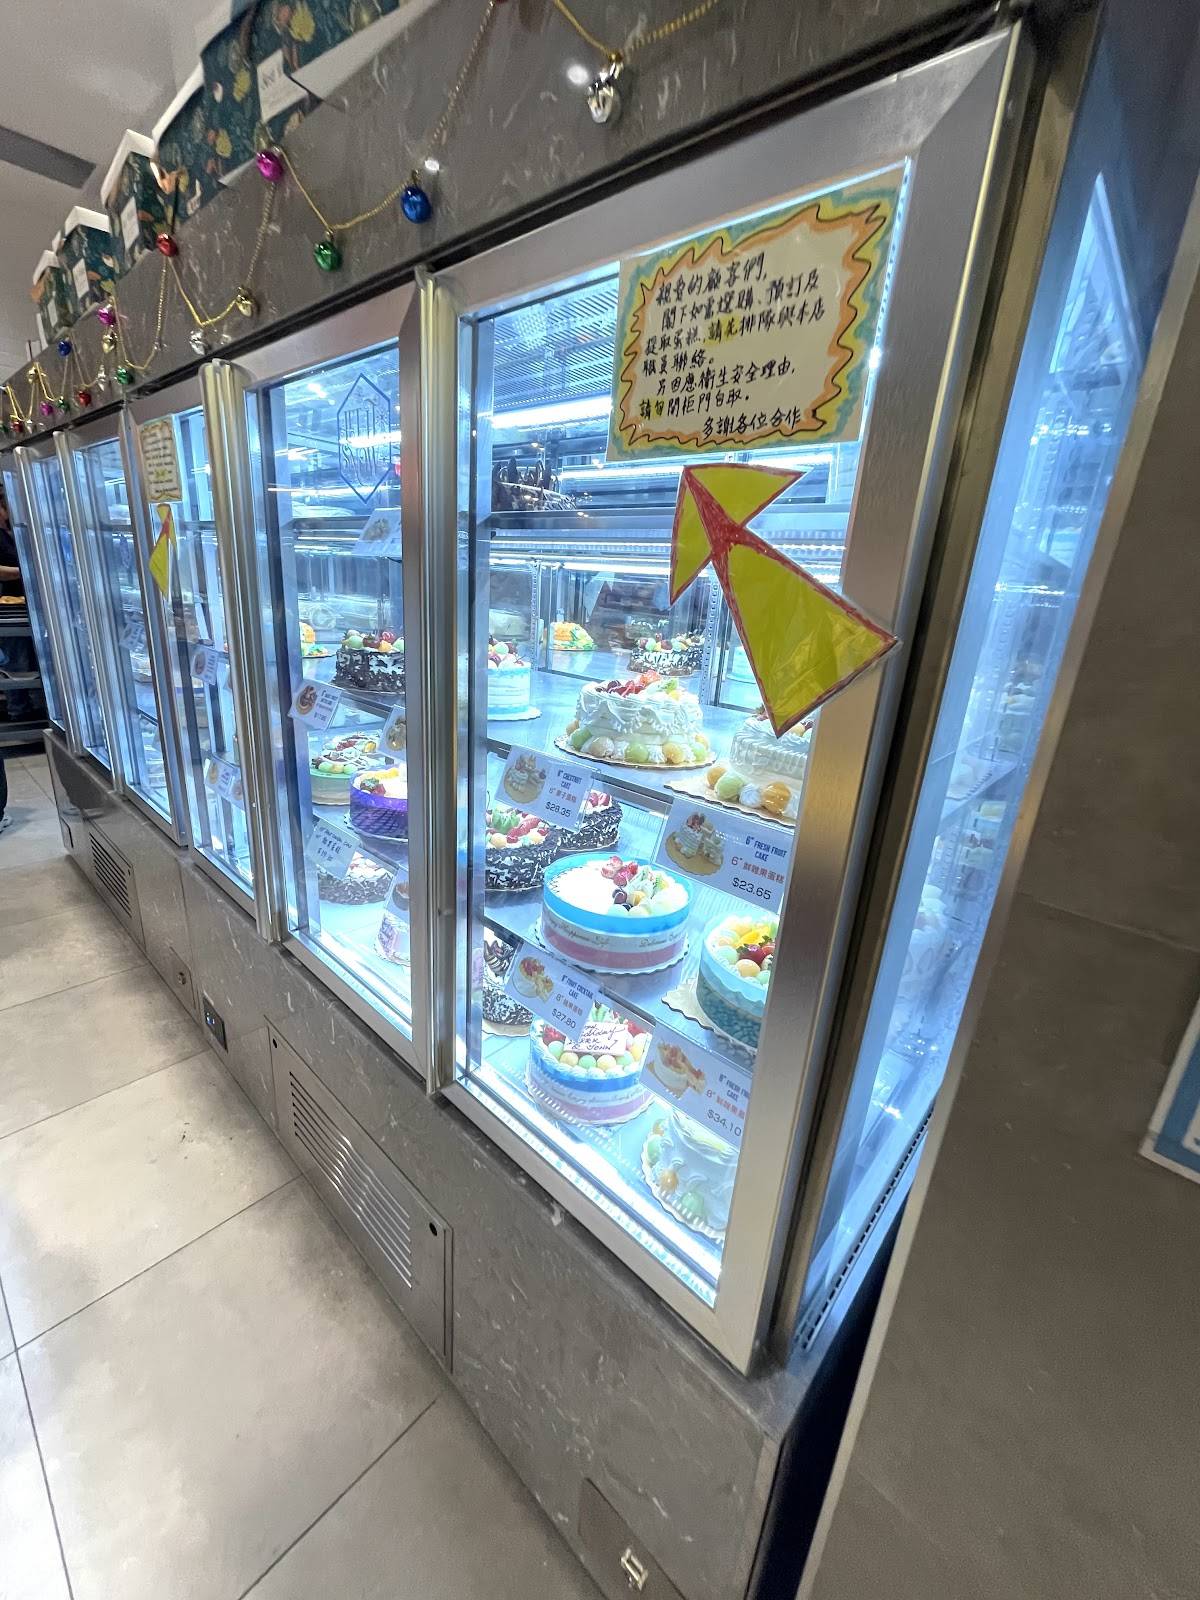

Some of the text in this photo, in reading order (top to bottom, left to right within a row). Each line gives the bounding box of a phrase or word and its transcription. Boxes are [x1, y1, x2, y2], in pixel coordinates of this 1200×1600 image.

[703, 407, 802, 439] 多謝各位合作
[545, 801, 571, 818] $28.35
[753, 840, 771, 853] FRESH
[771, 847, 788, 859] FRUIT
[754, 851, 769, 862] CAKE
[732, 877, 772, 900] $23.65
[552, 1008, 577, 1029] $27.80
[707, 1109, 742, 1137] $34.10
